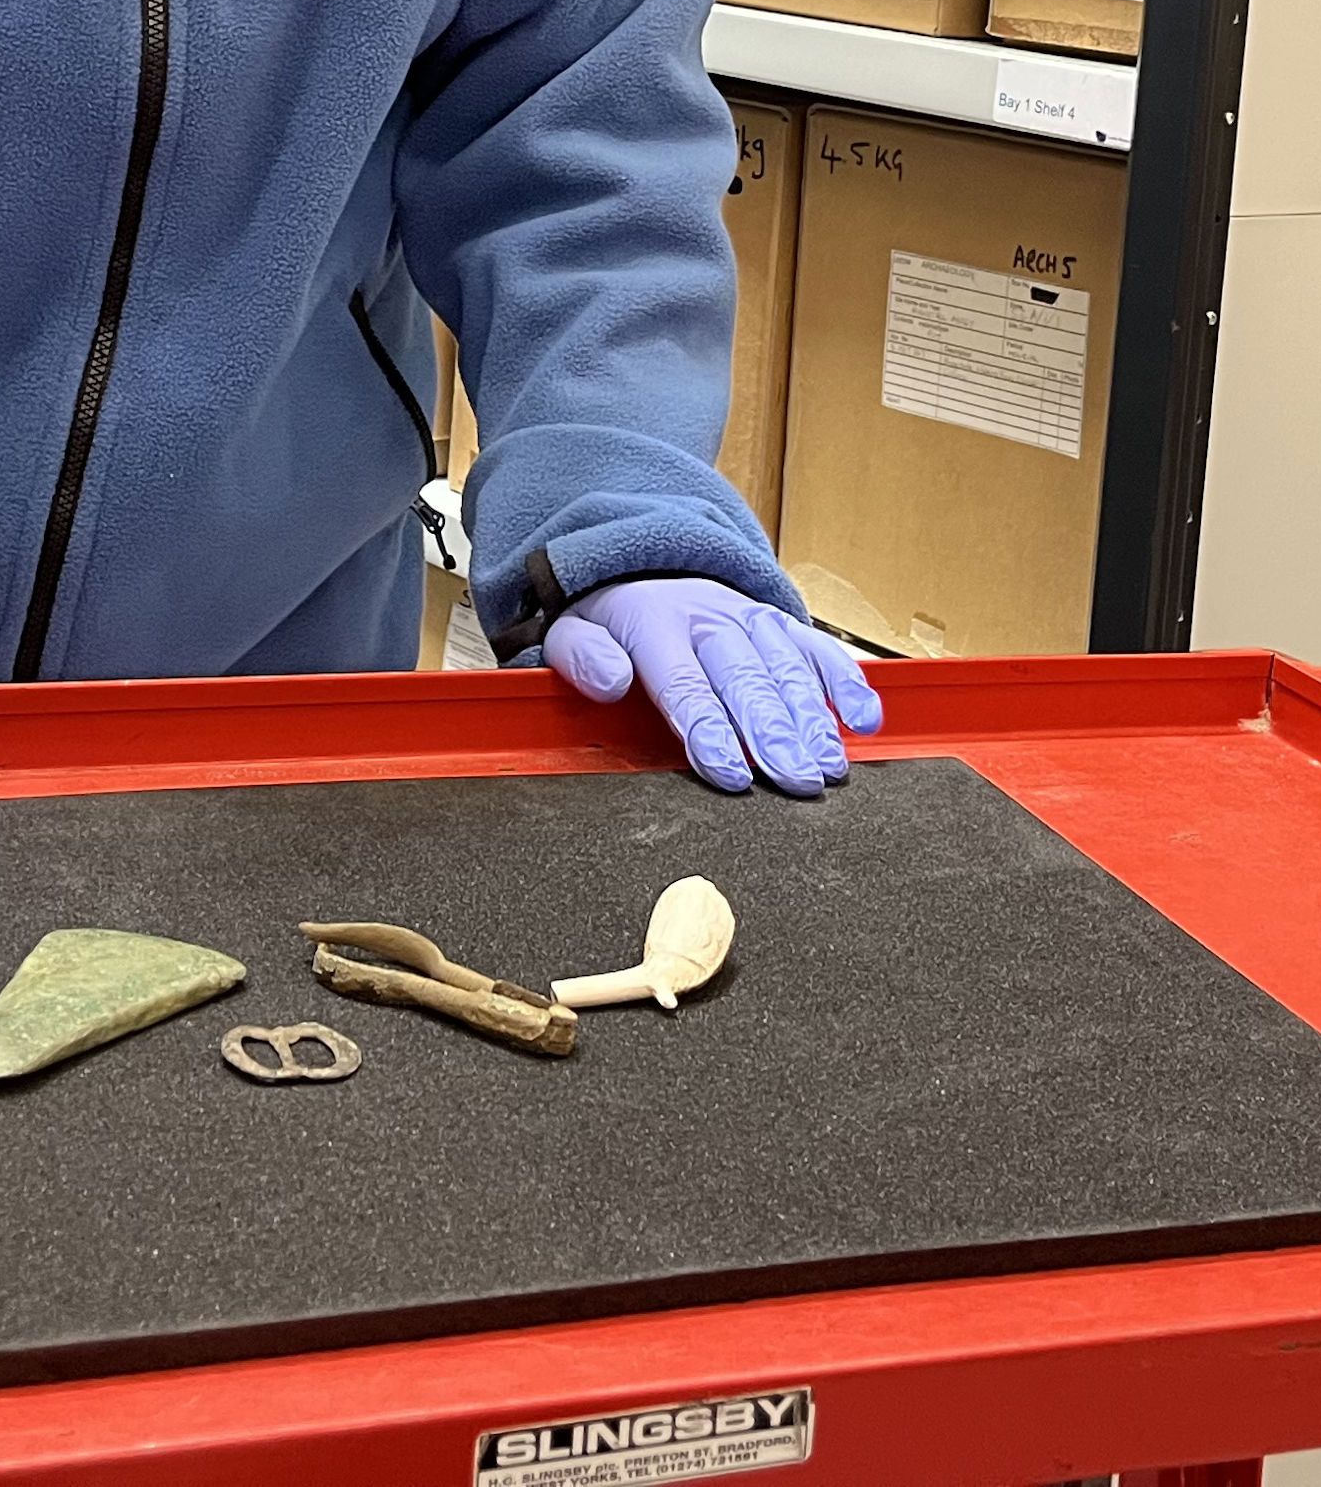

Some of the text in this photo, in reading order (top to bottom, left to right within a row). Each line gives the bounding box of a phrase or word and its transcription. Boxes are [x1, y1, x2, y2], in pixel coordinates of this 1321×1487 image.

[999, 92, 1076, 120] Bay 1 Shelf 4
[496, 1395, 796, 1467] SLINGSBY
[522, 1465, 591, 1485] SLINGSBY
[624, 1451, 690, 1469] PRESTON
[570, 1471, 622, 1486] YORKS,
[627, 1467, 652, 1479] TEL
